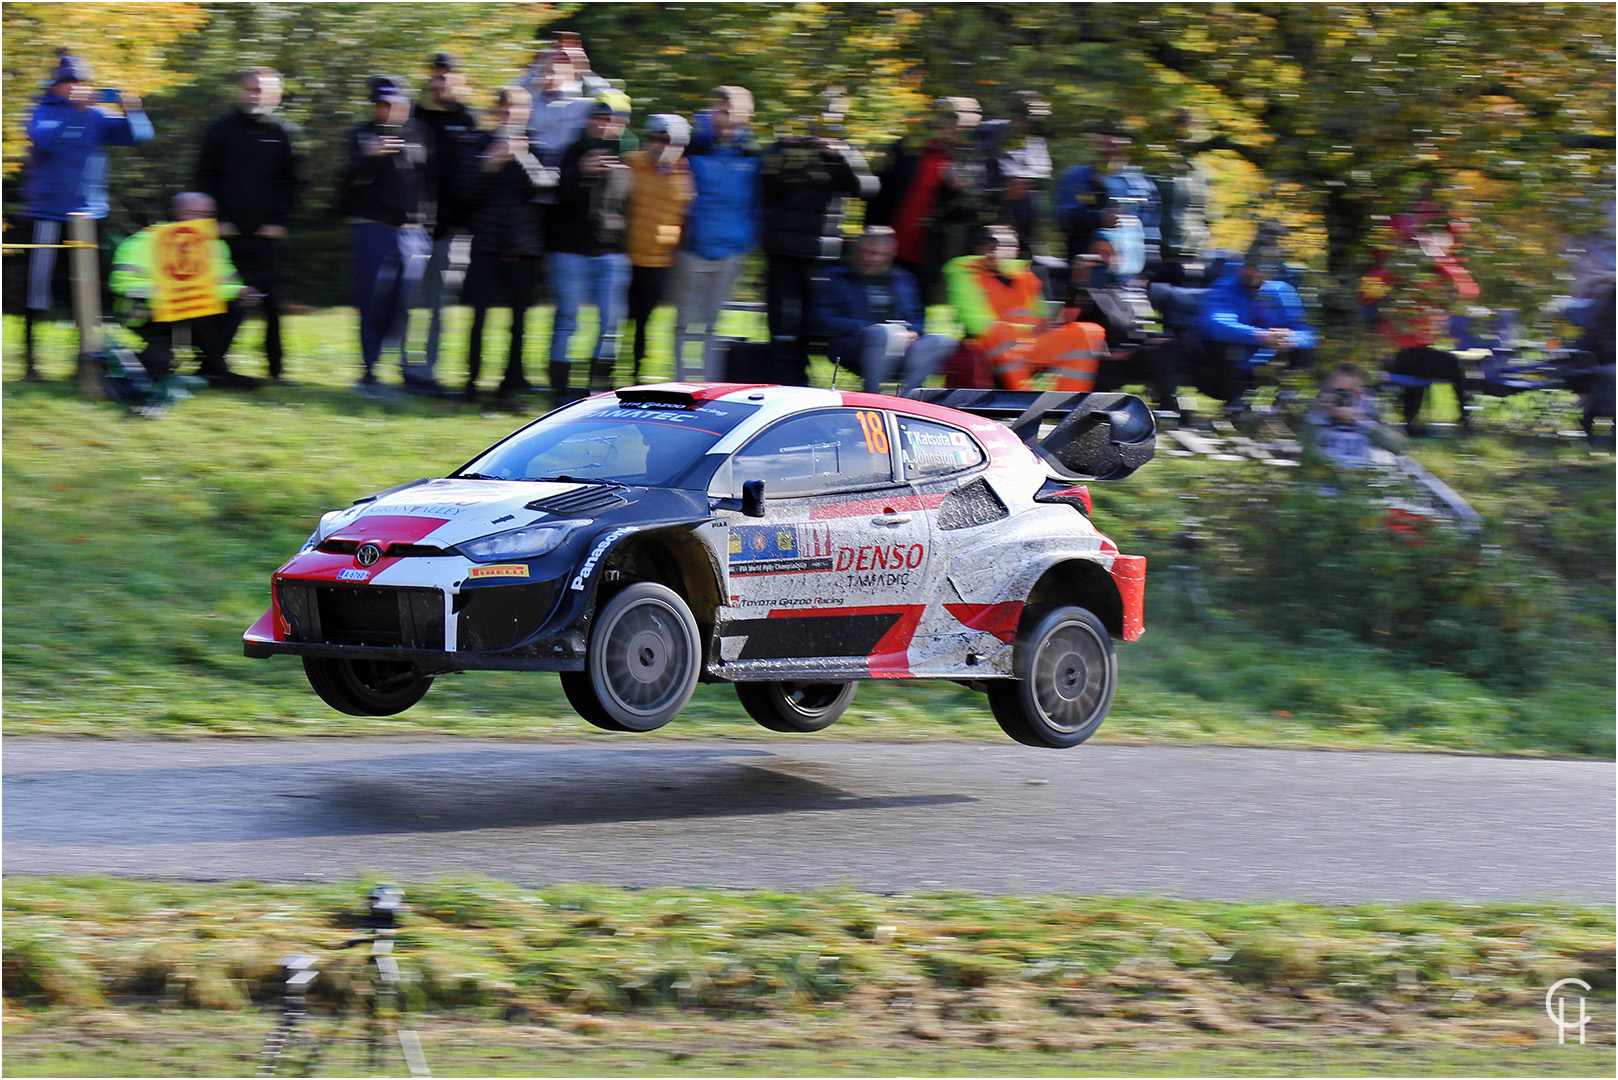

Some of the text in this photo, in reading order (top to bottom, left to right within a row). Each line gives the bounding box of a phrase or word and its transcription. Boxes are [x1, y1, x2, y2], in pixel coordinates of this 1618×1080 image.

[576, 409, 695, 422] FANATEC
[855, 410, 889, 455] 18
[570, 526, 640, 591] Panasonic
[835, 543, 924, 572] DENSO
[473, 566, 525, 576] PIRELLI
[740, 599, 777, 608] TOYOTA
[778, 598, 812, 606] GAZOO
[813, 597, 844, 606] Racing
